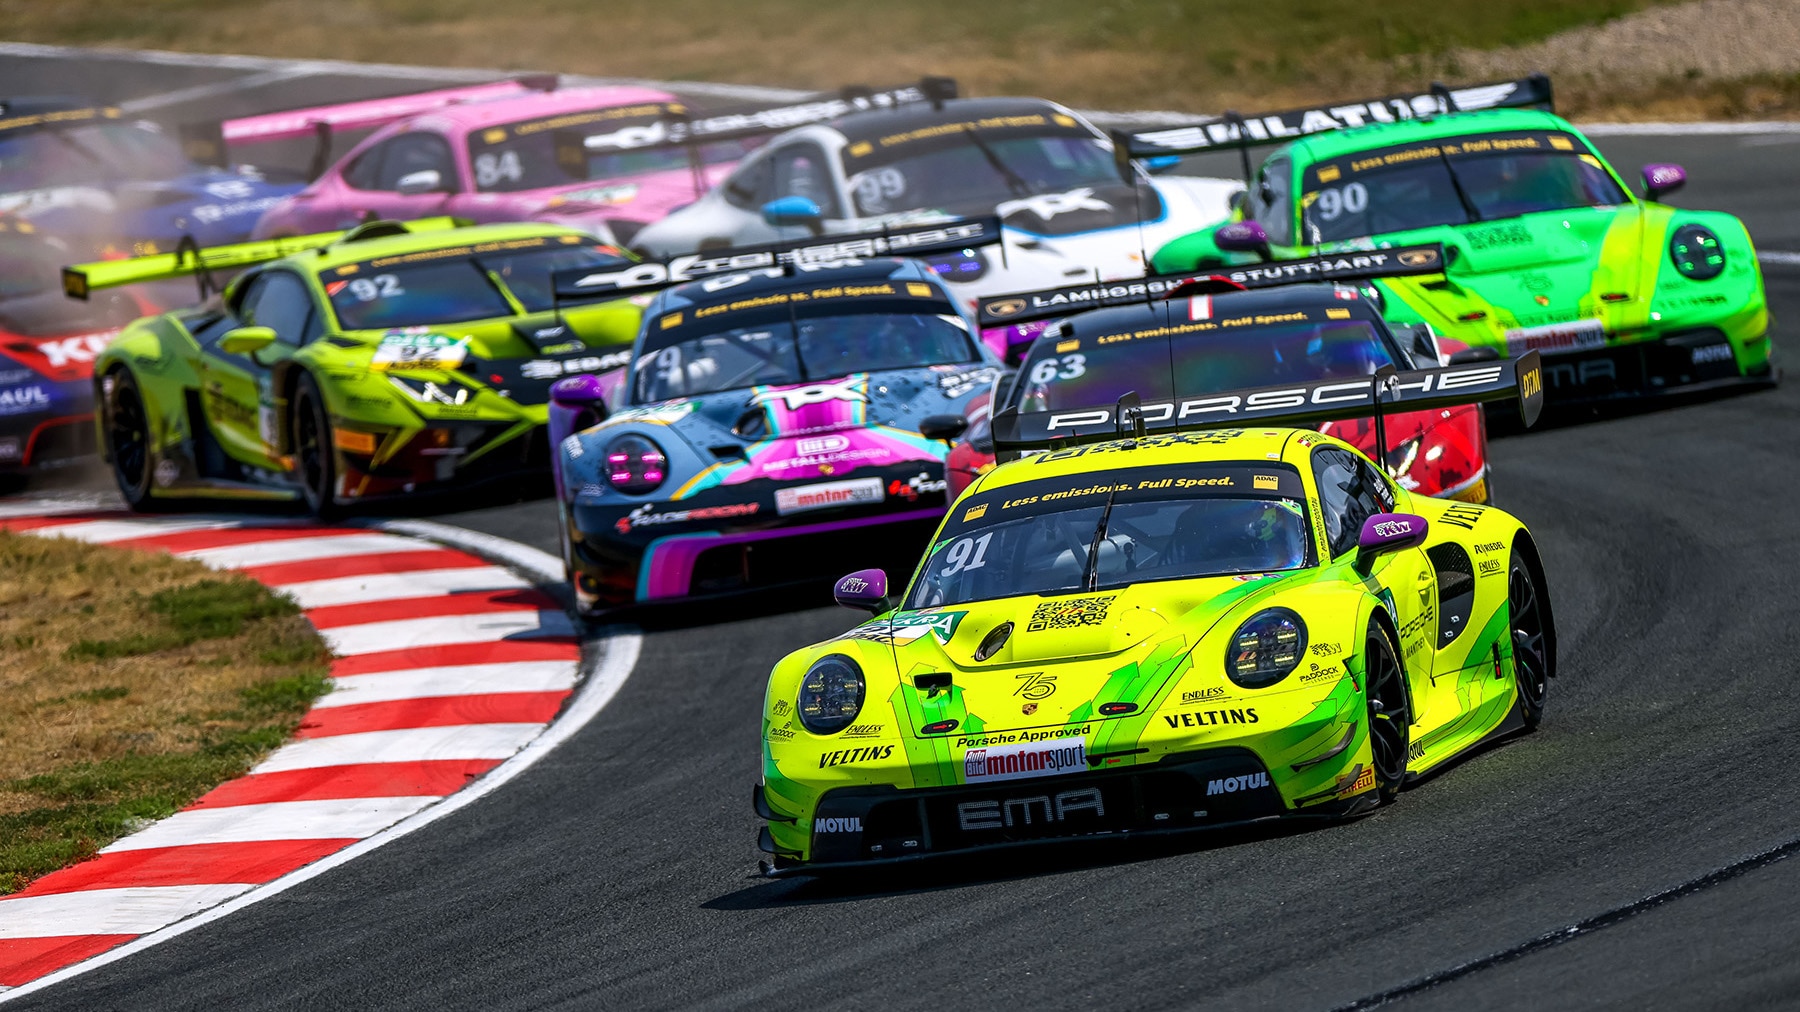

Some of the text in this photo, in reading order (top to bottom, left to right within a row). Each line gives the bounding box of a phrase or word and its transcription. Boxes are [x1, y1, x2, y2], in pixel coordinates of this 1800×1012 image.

[475, 150, 523, 187] 84
[857, 167, 905, 203] 99
[1318, 181, 1369, 221] 90
[350, 273, 405, 302] 92
[1033, 279, 1184, 308] LAMBORGH
[1097, 332, 1132, 345] Less
[1221, 314, 1253, 328] Full
[1255, 310, 1309, 325] Speed.
[1030, 353, 1087, 384] 63
[0, 386, 50, 405] AUL
[1522, 367, 1541, 399] DTM
[1047, 365, 1502, 432] PORSCHE
[1001, 494, 1038, 509] Less
[1138, 478, 1172, 491] Full
[1174, 476, 1235, 489] Speed.
[1380, 522, 1411, 537] KW
[1438, 503, 1486, 531] VELT
[940, 532, 994, 577] 91
[1484, 541, 1506, 553] RIEDEL
[1479, 558, 1501, 573] ENDLESS
[1012, 671, 1058, 701] 75
[1299, 666, 1339, 682] PADDOCK
[1182, 686, 1225, 701] ENDLESS
[845, 724, 885, 735] ENDLESS
[1163, 708, 1259, 729] VELTINS
[956, 725, 1091, 748] Porsche Approved
[818, 745, 895, 770] VELTINS
[965, 750, 986, 761] Auto
[967, 761, 986, 776] Bild
[987, 743, 1086, 776] motorsport
[1206, 771, 1270, 797] MOTUL
[1341, 776, 1373, 795] RELLI
[957, 786, 1106, 831] EMA
[815, 816, 864, 834] MOTUL
